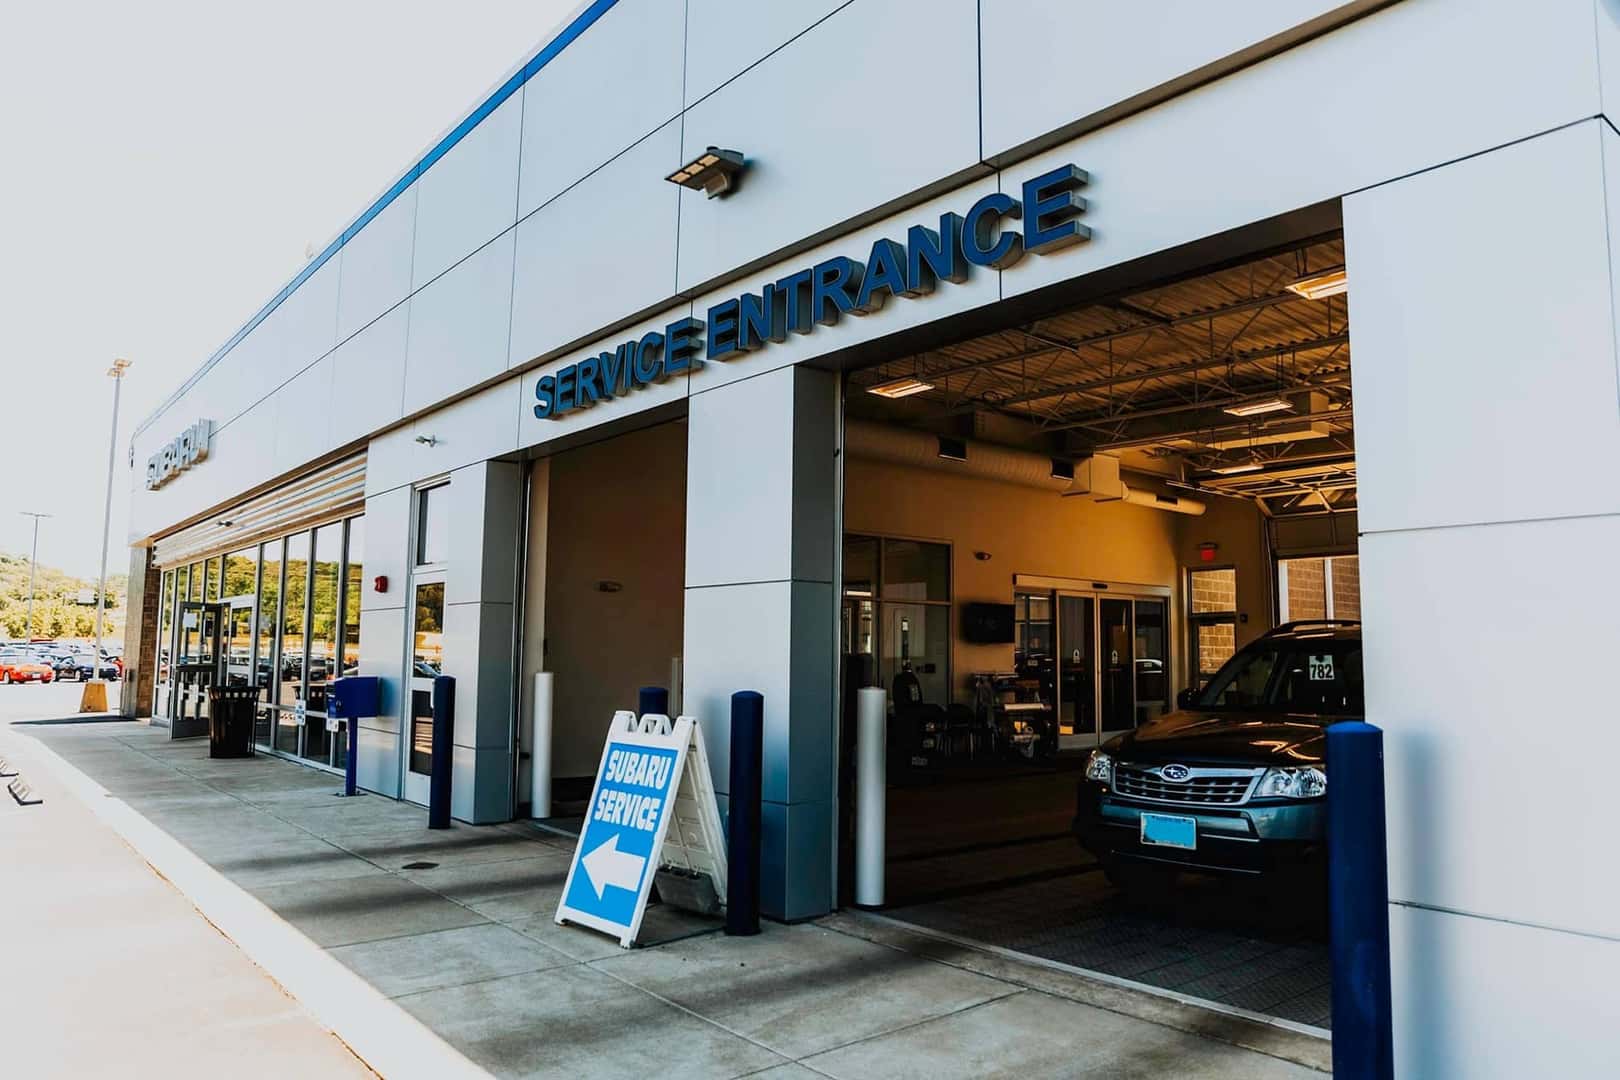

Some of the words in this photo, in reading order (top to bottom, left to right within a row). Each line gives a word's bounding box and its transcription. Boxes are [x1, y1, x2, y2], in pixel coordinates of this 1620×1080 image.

[534, 317, 700, 419] SERVICE
[707, 163, 1088, 360] ENTRANCE
[1310, 663, 1333, 679] 782
[606, 750, 671, 788] SUBARU
[595, 789, 661, 831] SERVICE
